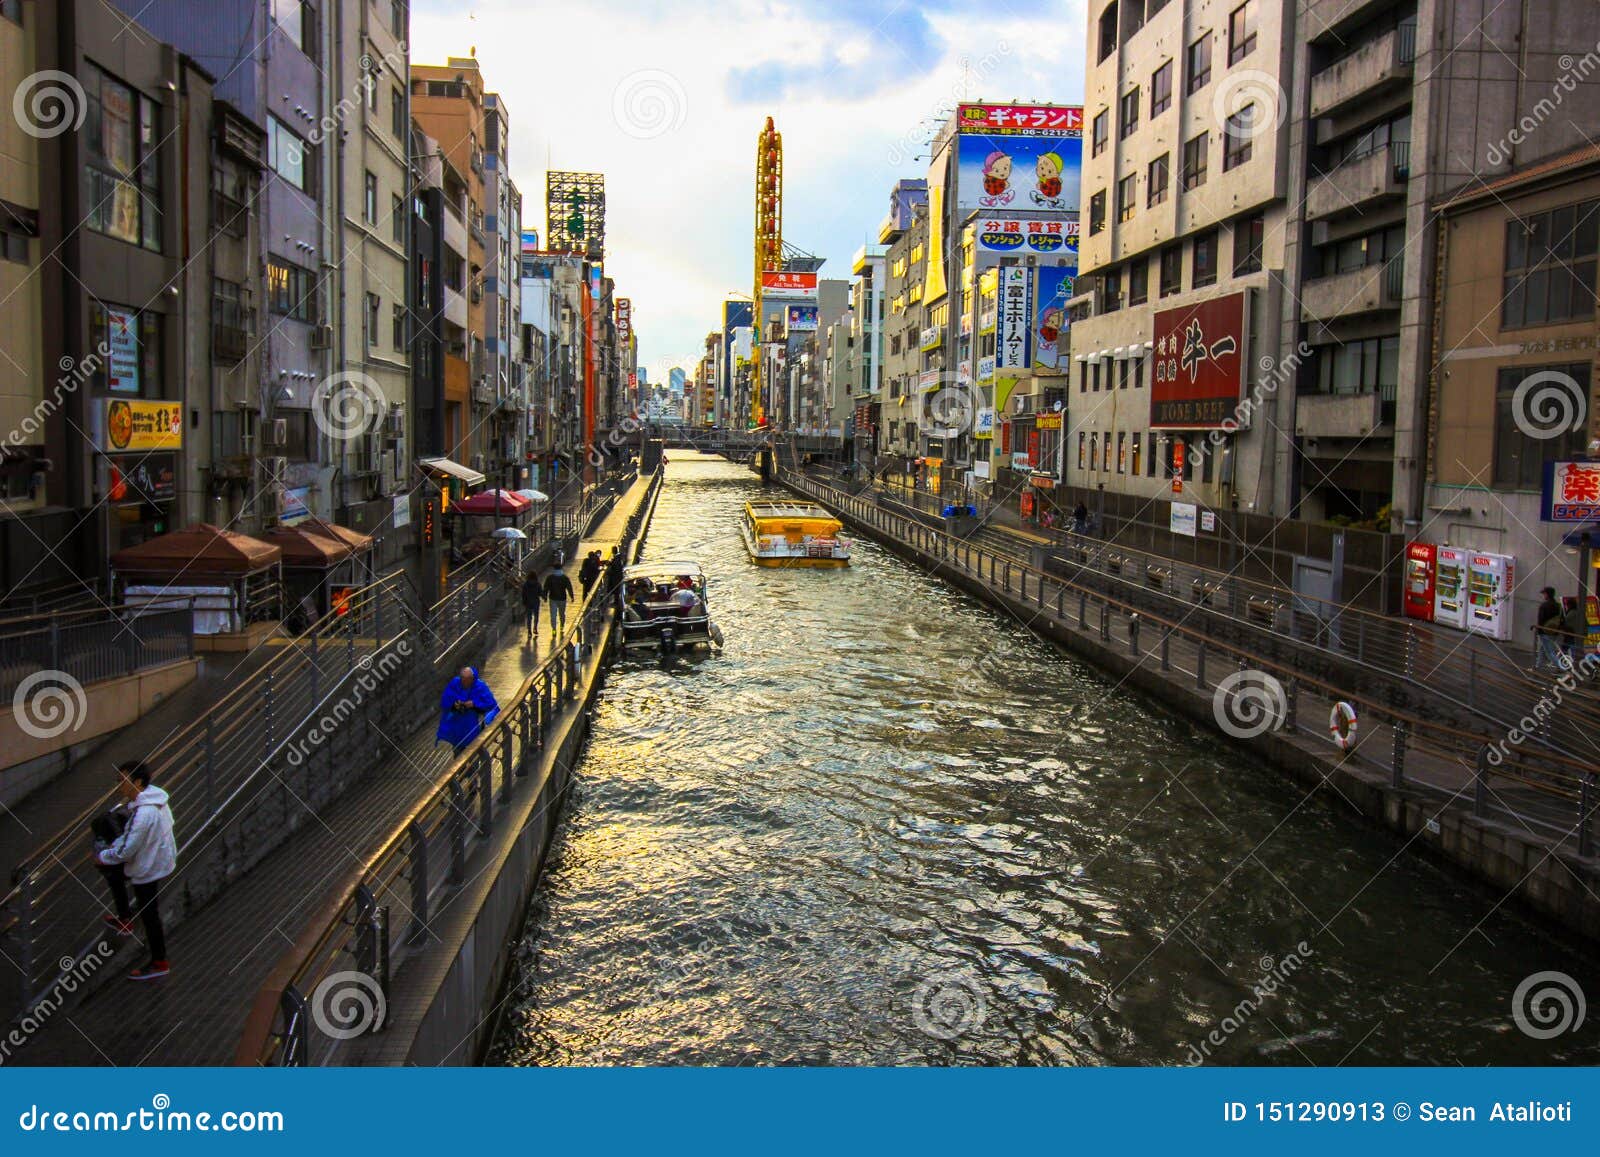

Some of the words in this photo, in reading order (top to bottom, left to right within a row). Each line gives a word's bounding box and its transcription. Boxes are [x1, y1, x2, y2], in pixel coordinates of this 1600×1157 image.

[988, 108, 1081, 128] ギャラント
[983, 234, 1023, 245] マンション
[1006, 285, 1024, 366] 富士ホームサービス
[1181, 317, 1237, 384] 牛一
[1161, 402, 1191, 421] KOBE
[1564, 463, 1599, 502] 薬
[1441, 551, 1456, 560] KIRIN
[1474, 557, 1490, 566] KIRIN
